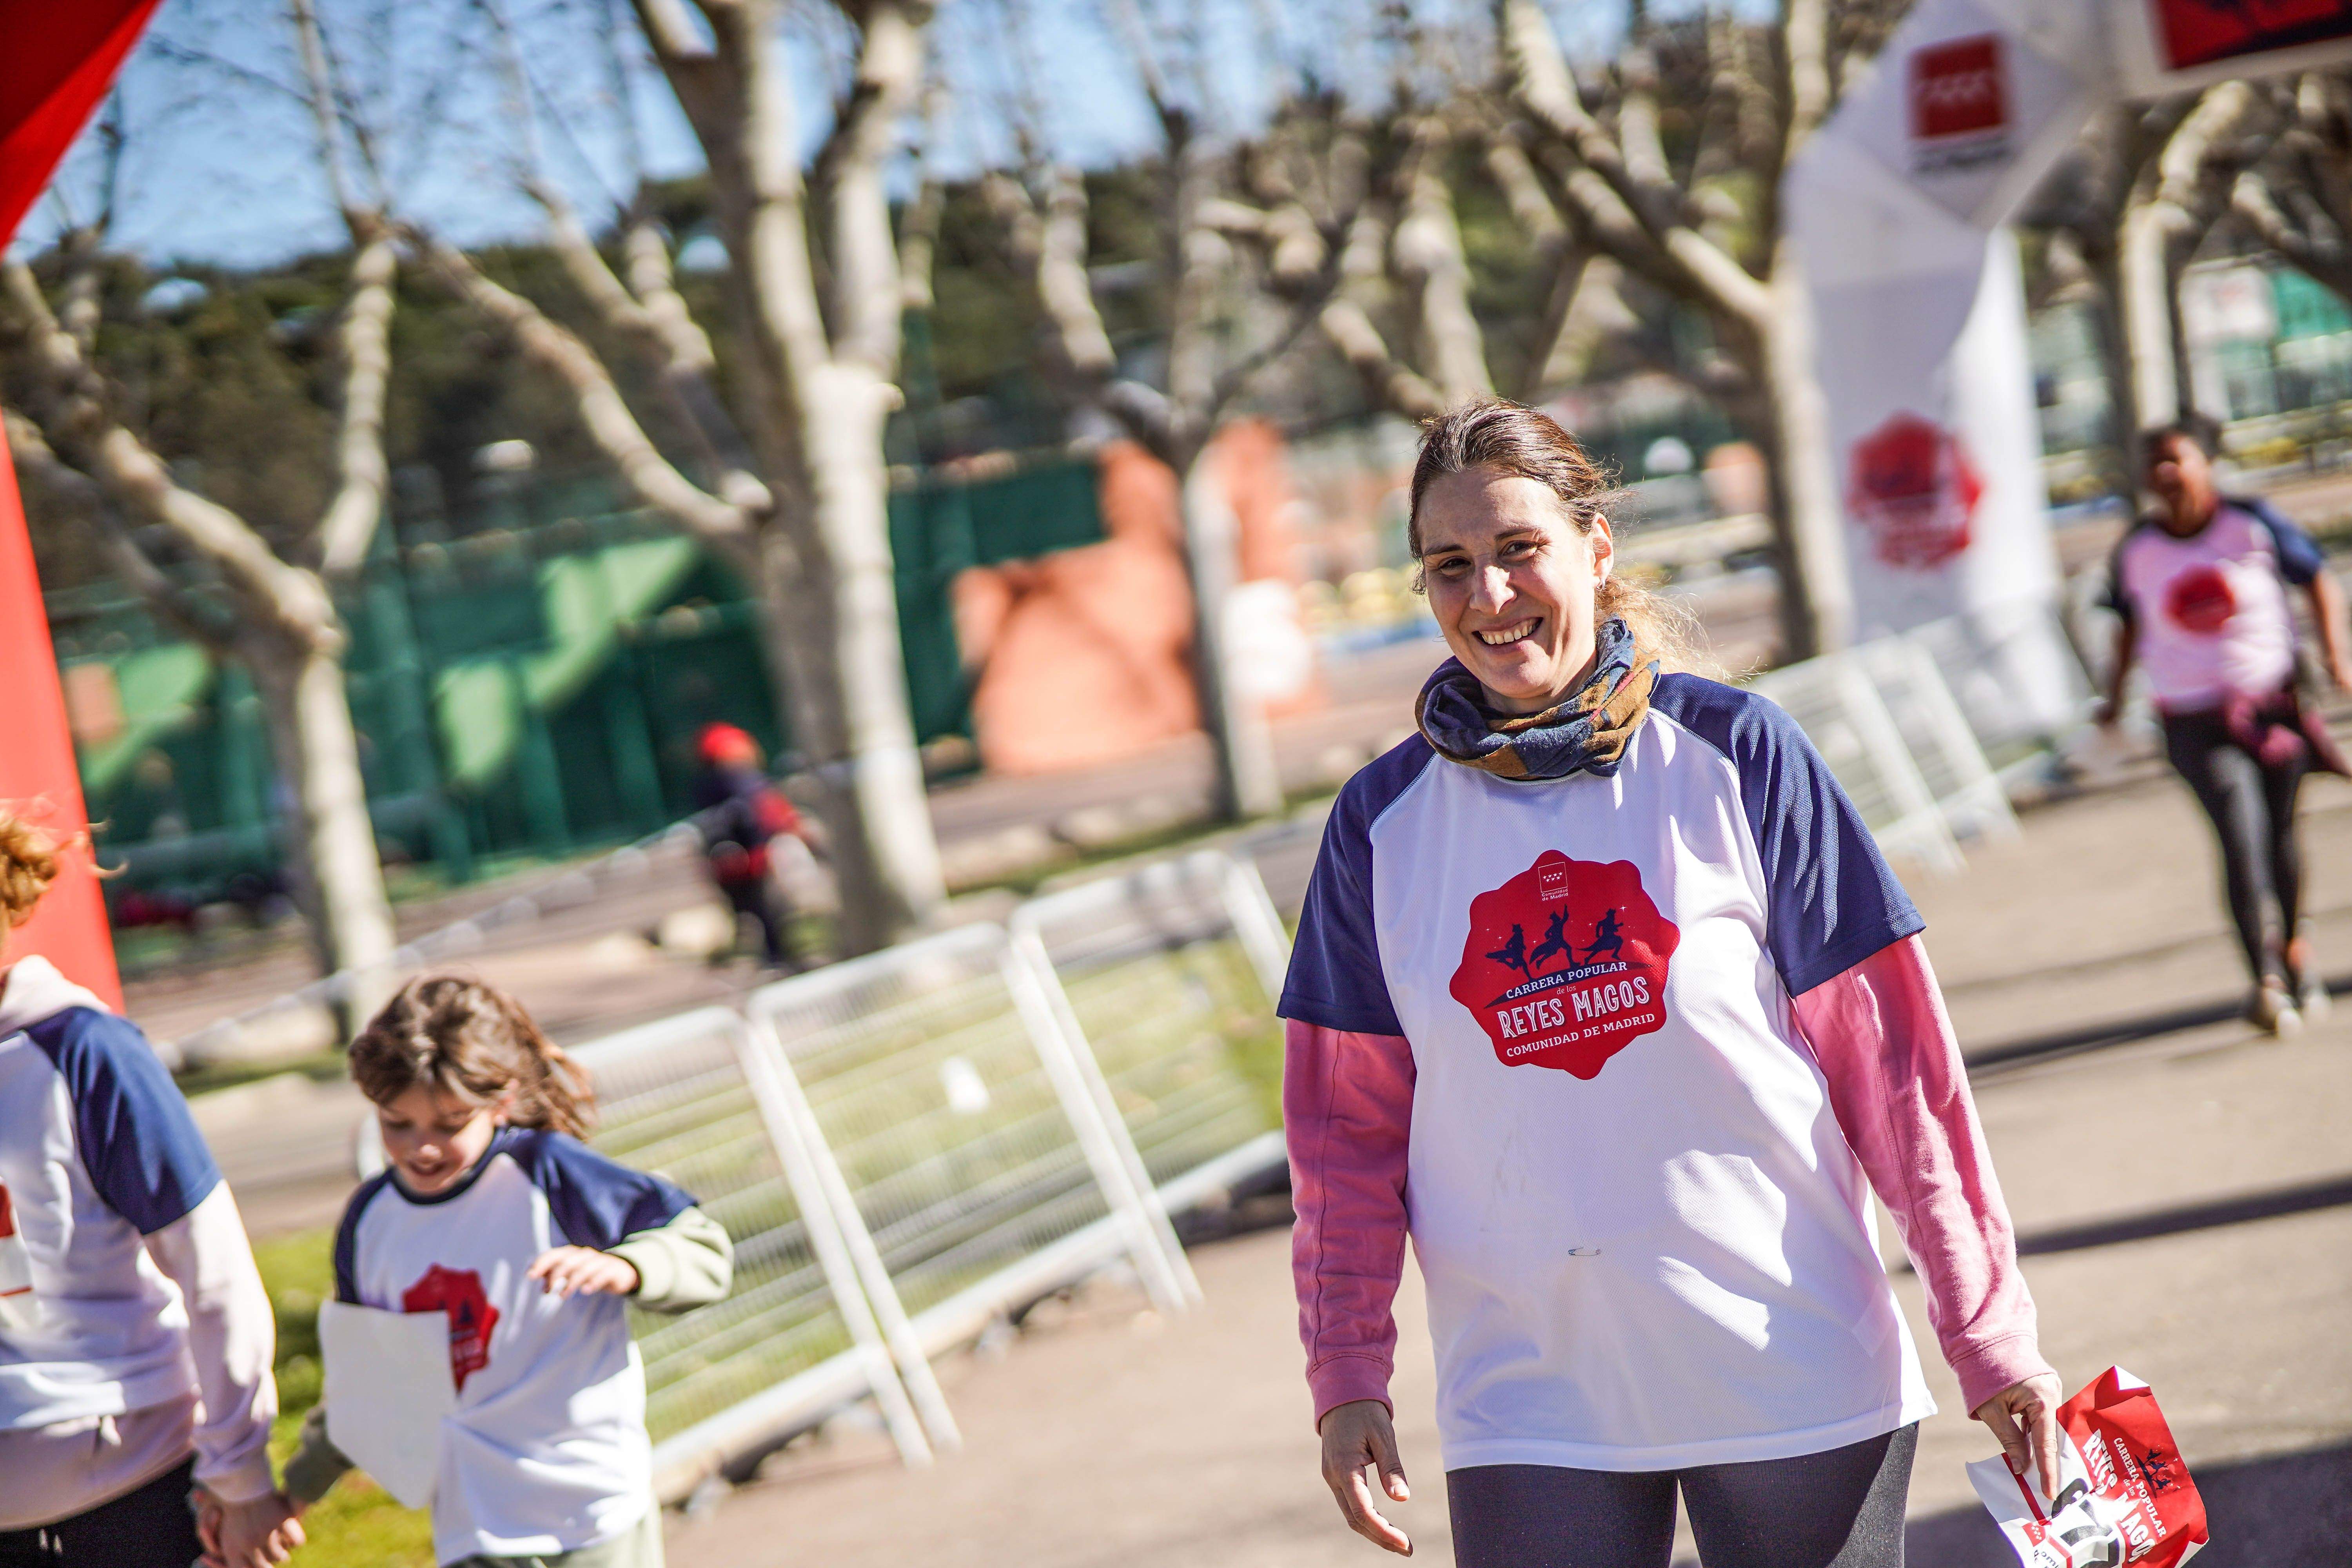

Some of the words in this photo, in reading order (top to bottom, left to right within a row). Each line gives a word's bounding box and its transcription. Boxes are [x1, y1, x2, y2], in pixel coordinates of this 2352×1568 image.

[1542, 888, 1568, 897] Comunidad
[1506, 974, 1564, 999] CARRERA
[1568, 962, 1627, 981] POPULAR
[1497, 998, 1565, 1039] REYES
[1571, 976, 1650, 1022] MAGOS
[1506, 1031, 1579, 1057] COMUNIDAD
[1583, 1026, 1601, 1038] DE
[1602, 1013, 1655, 1033] MADRID
[2082, 1428, 2118, 1495] REYES
[2123, 1478, 2131, 1487] de
[2114, 1437, 2140, 1483] CARRERA
[2136, 1481, 2167, 1537] POPULAR
